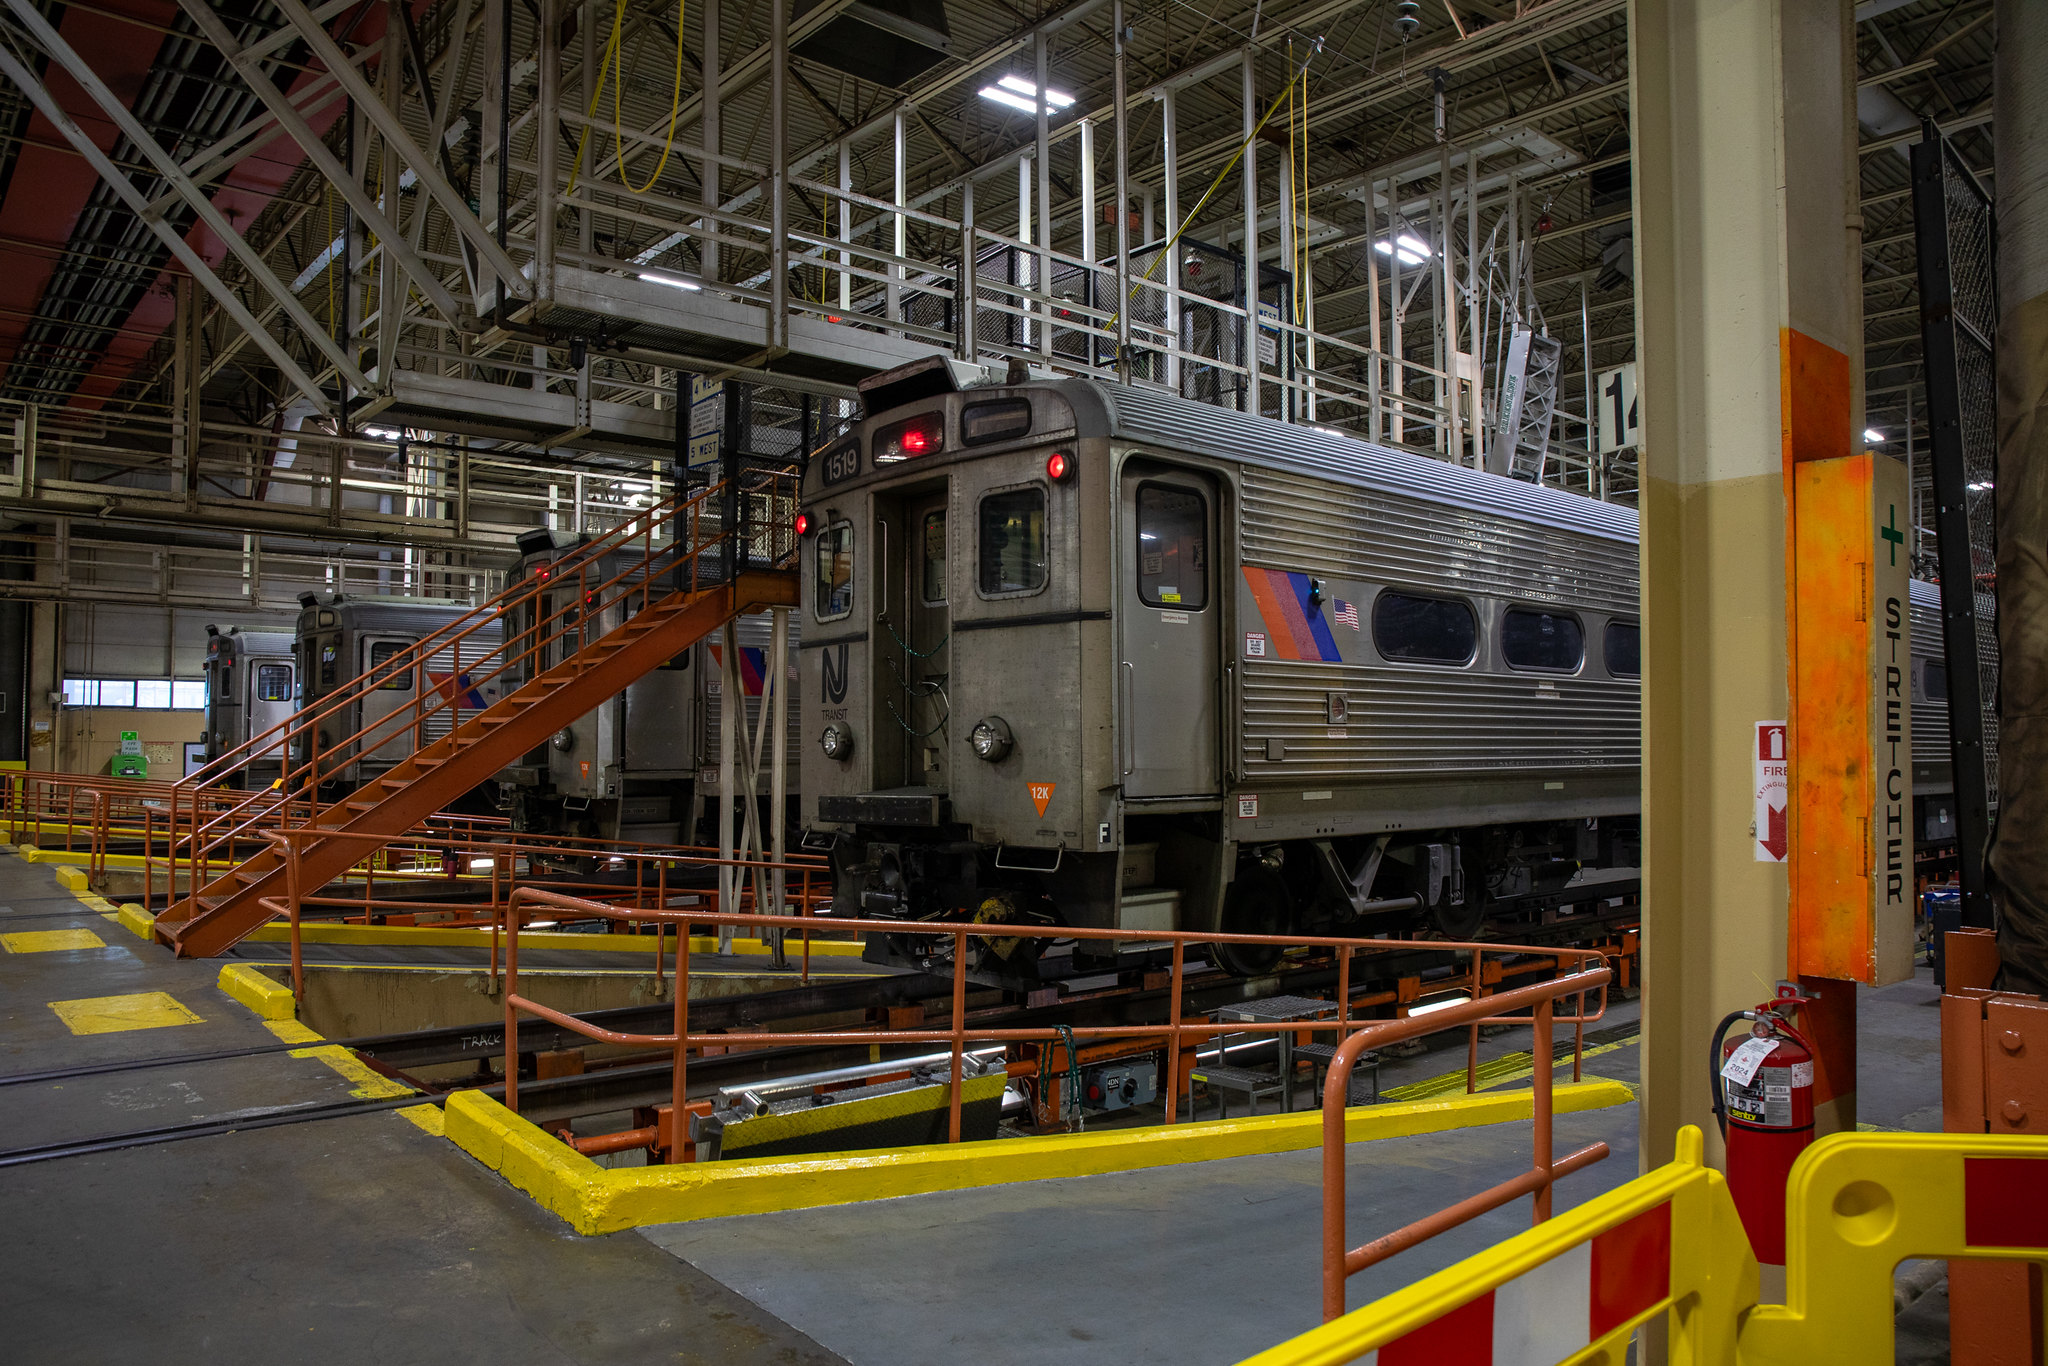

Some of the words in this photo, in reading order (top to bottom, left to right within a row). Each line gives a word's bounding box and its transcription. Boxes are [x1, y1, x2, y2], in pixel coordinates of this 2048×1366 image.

[694, 384, 699, 394] 4
[691, 446, 696, 458] 5
[700, 441, 717, 455] WEST
[826, 449, 857, 481] 1519
[822, 709, 848, 721] TRANSIT
[1885, 597, 1904, 906] STRETCHER
[1031, 786, 1049, 800] 12K
[1099, 823, 1109, 843] F
[461, 1034, 501, 1050] TRACK
[1730, 1064, 1749, 1076] 2024
[1731, 1109, 1756, 1121] sentry
